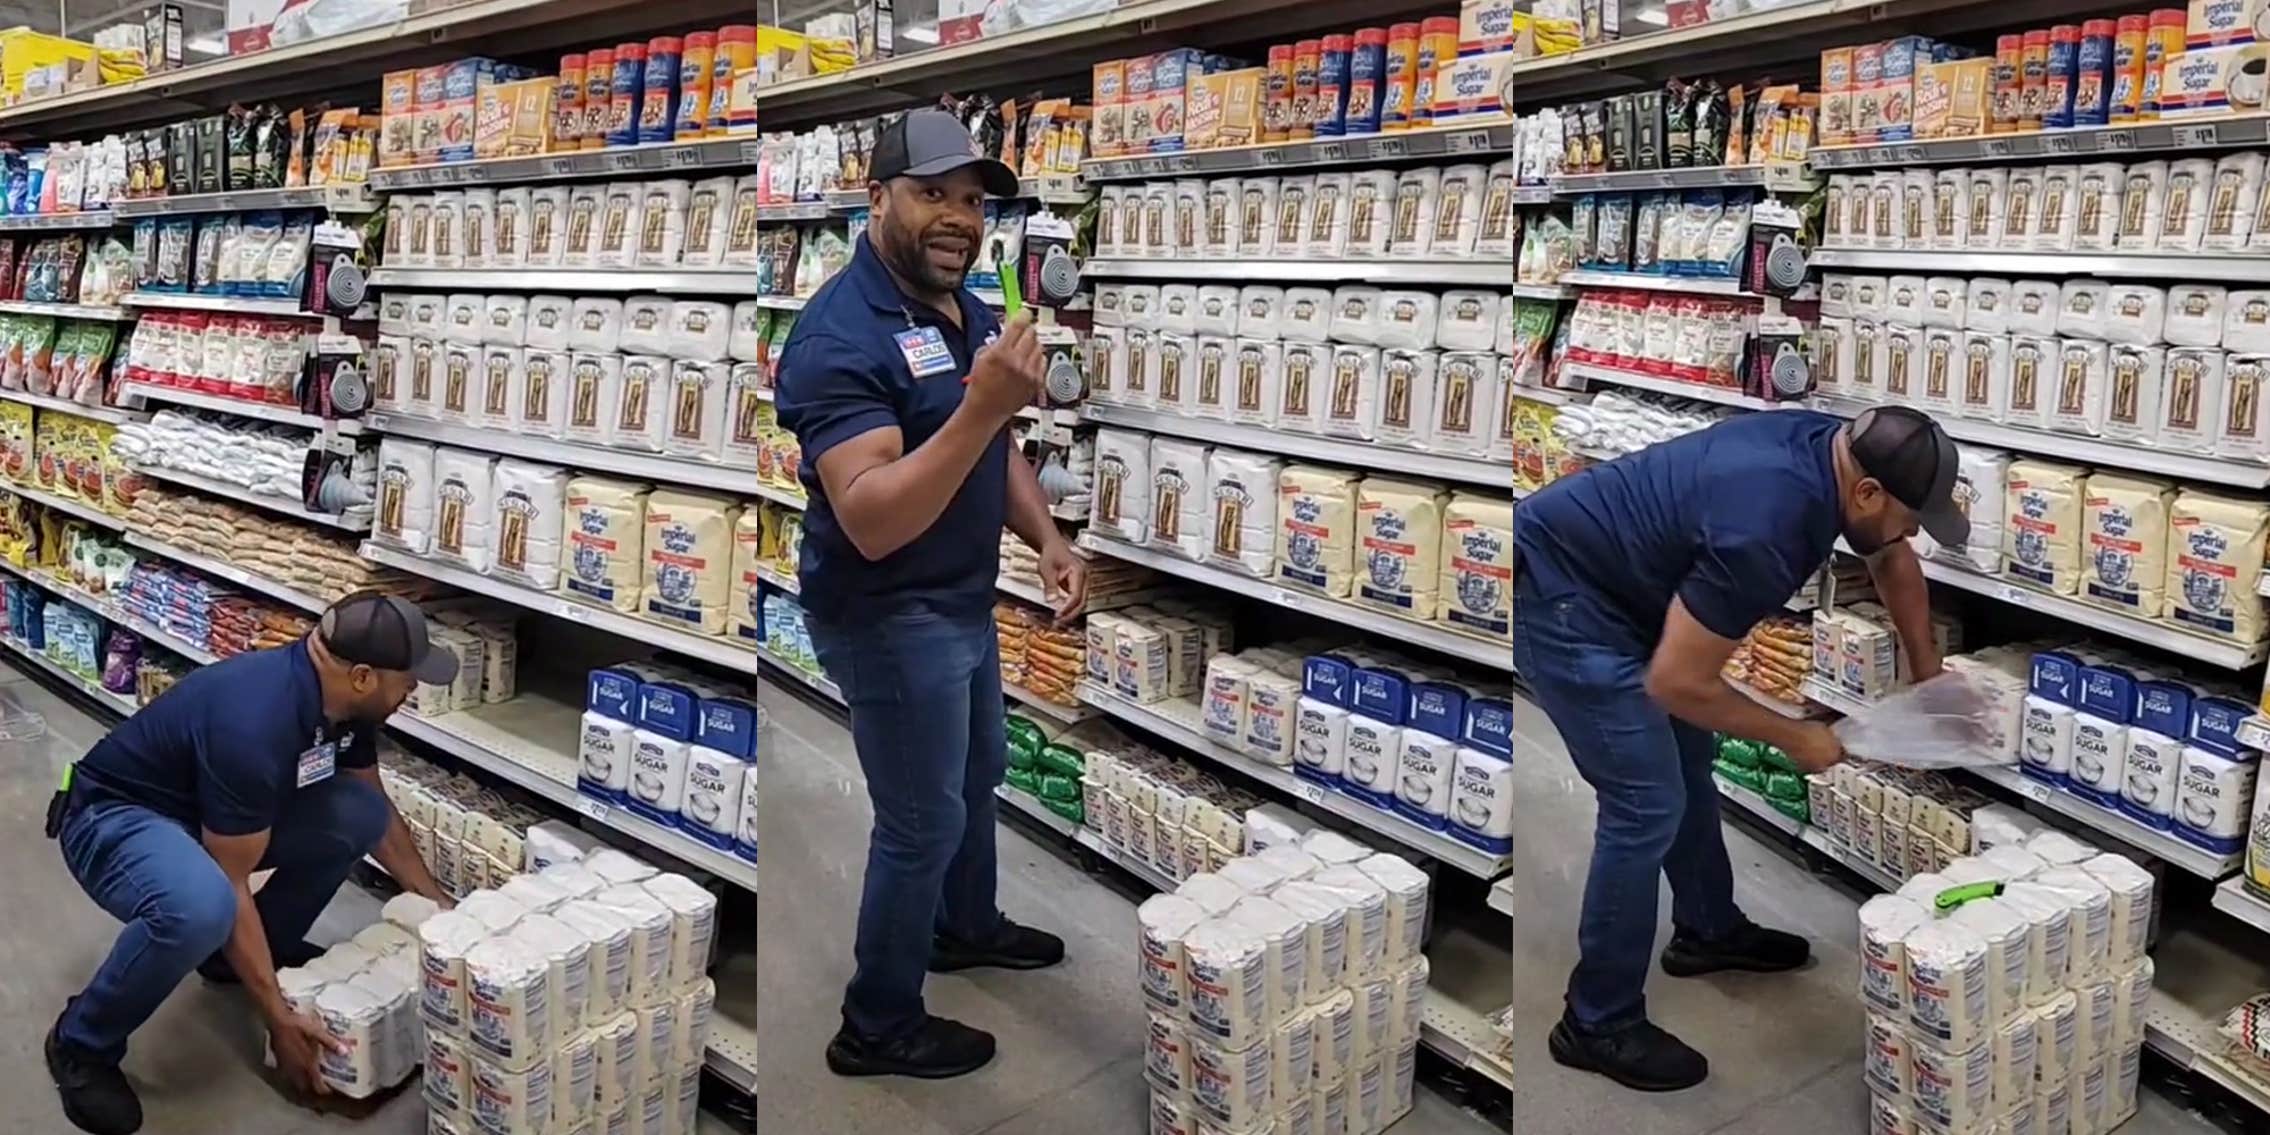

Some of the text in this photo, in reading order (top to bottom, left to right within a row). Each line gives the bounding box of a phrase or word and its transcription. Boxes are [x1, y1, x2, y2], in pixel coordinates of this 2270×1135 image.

[1452, 68, 1491, 84] Imperial
[2179, 61, 2218, 77] Imperial
[1456, 84, 1484, 96] Sugar
[2183, 78, 2211, 91] Sugar
[1419, 701, 1446, 716] SUGAR
[2145, 700, 2172, 714] SUGAR
[1476, 719, 1506, 735] SUGAR
[2201, 717, 2231, 734] SUGAR
[584, 734, 615, 753] SUGAR
[1349, 736, 1382, 756] SUGAR
[2075, 735, 2109, 756] SUGAR
[634, 752, 668, 773] SUGAR
[1403, 755, 1438, 776] SUGAR
[2128, 754, 2163, 775] SUGAR
[689, 771, 725, 794] SUGAR
[1458, 775, 1495, 798] SUGAR
[2183, 775, 2220, 798] SUGAR
